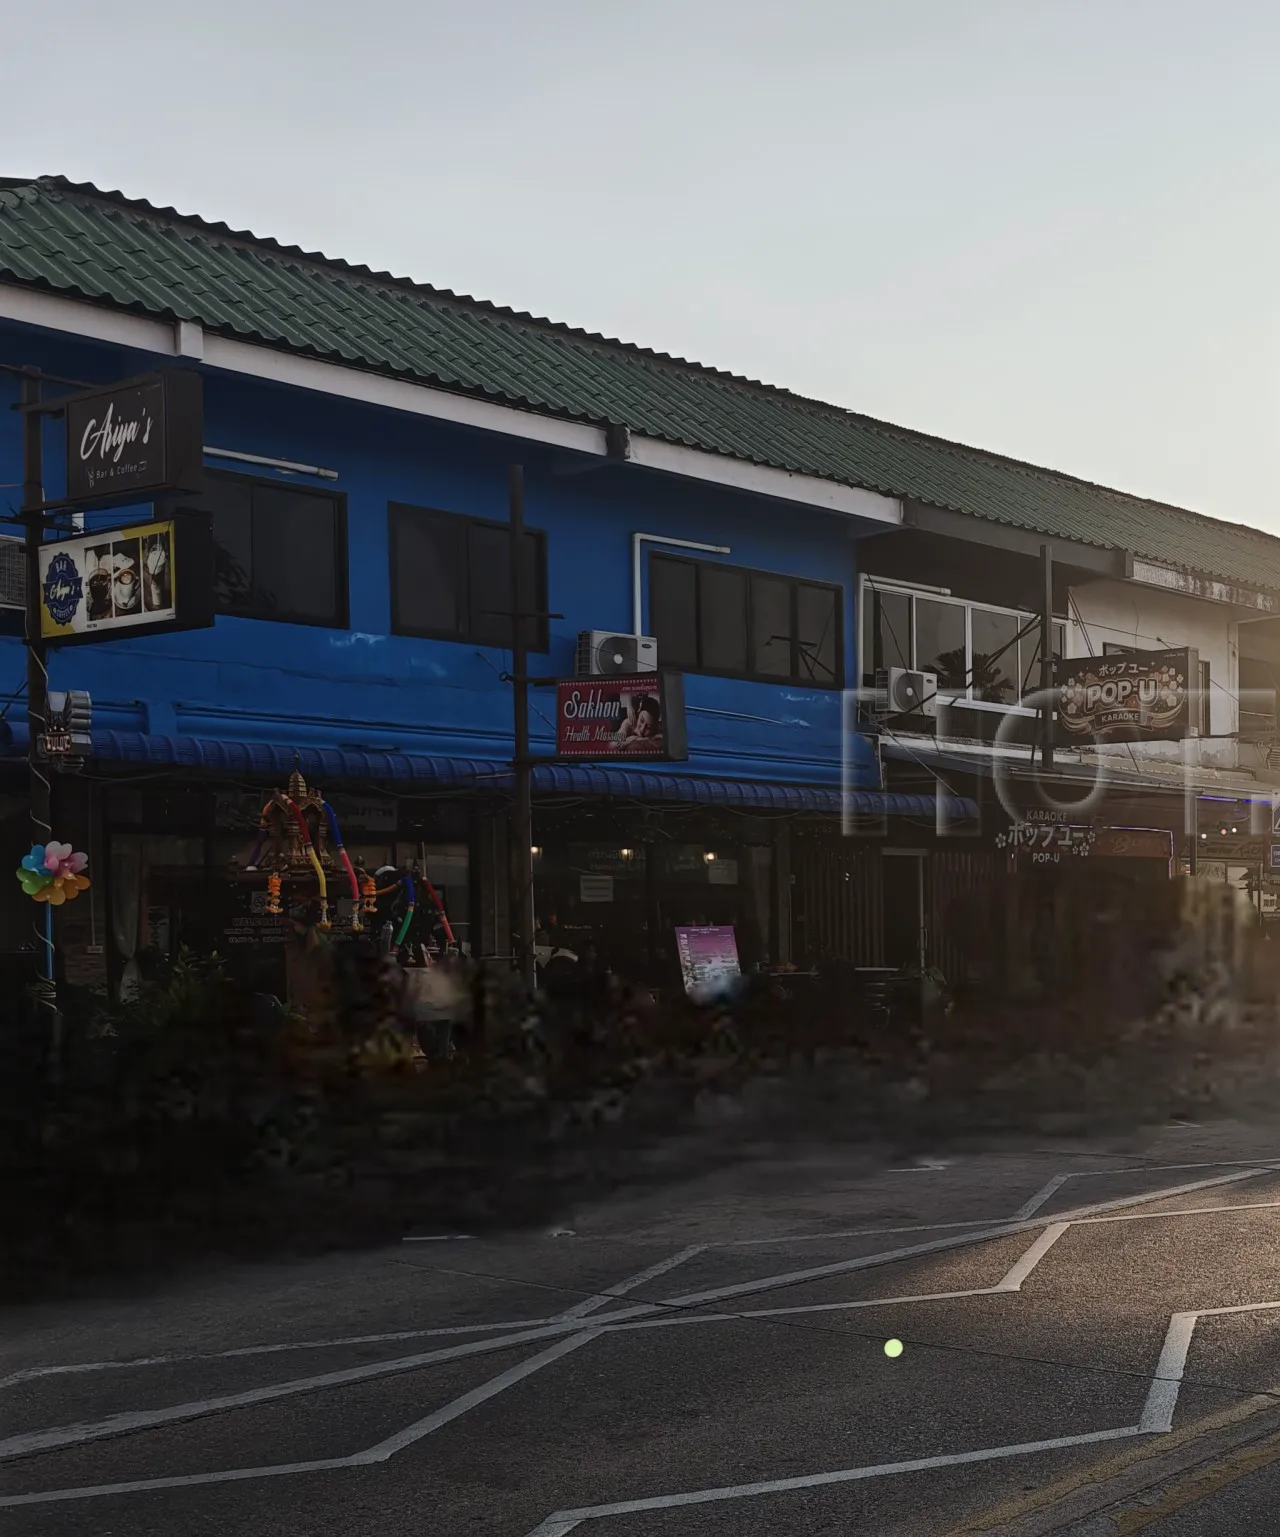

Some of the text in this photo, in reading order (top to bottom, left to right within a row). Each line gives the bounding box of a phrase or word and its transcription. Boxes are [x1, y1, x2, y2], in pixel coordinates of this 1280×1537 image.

[81, 402, 153, 463] Ariya's
[96, 470, 107, 479] Bar
[117, 464, 138, 475] Coffee
[1086, 678, 1157, 711] POP-U
[564, 689, 620, 719] Sakhon
[1101, 712, 1139, 723] KARAOKE
[1026, 810, 1067, 822] KARAOKE
[1032, 853, 1060, 863] POP-U
